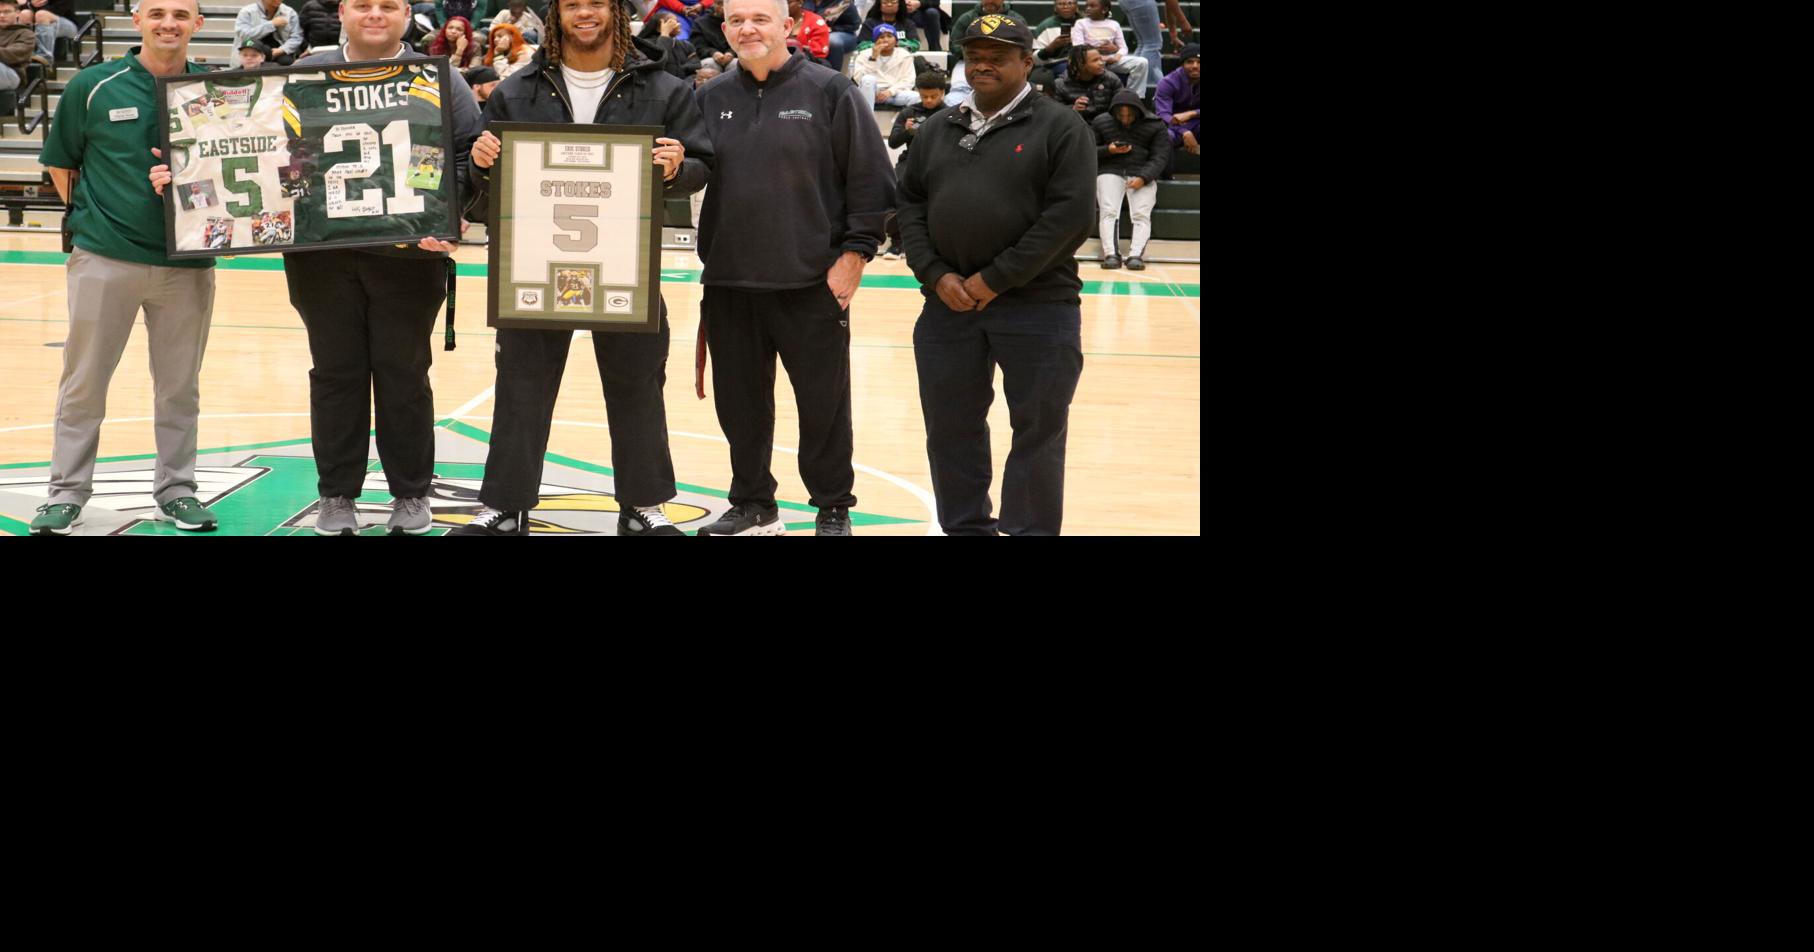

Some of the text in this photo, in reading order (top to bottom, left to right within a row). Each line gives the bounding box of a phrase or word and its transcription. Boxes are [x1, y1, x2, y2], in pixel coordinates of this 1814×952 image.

[325, 81, 410, 113] STOKES
[198, 136, 278, 158] EASTSIDE
[221, 156, 264, 218] 5
[323, 119, 425, 219] 21
[540, 180, 612, 199] STOKES
[552, 203, 599, 253] 5
